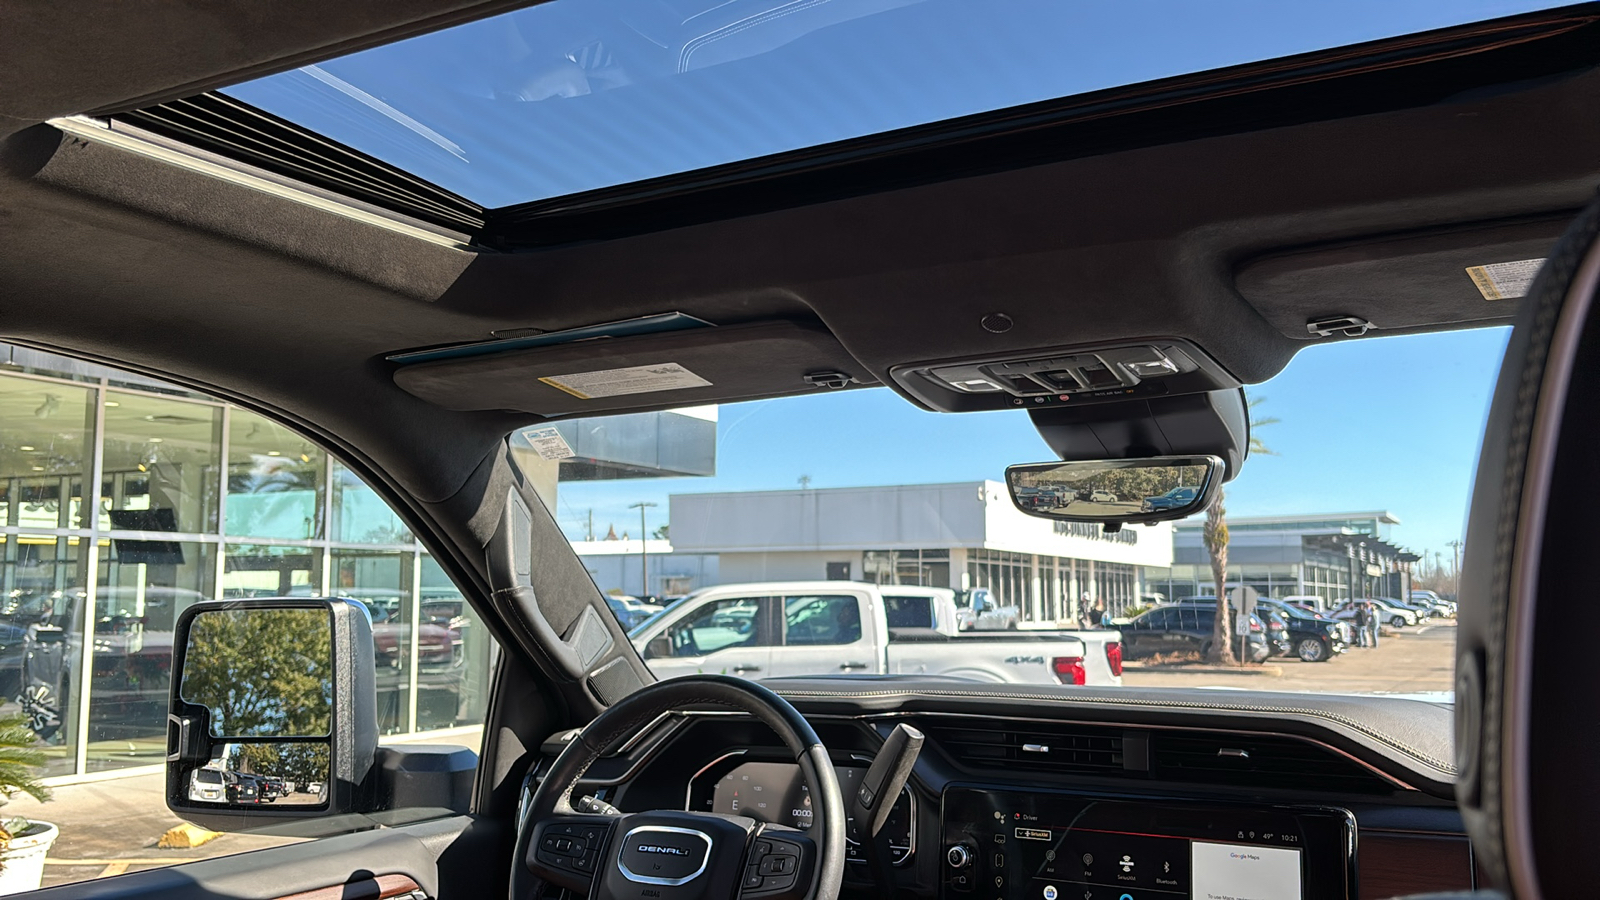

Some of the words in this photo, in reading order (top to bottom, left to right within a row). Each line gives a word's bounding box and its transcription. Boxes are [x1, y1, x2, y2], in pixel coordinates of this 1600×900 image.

[732, 800, 738, 811] E
[1281, 834, 1298, 842] 10:21
[638, 845, 689, 856] DENALI
[1230, 852, 1246, 860] Google
